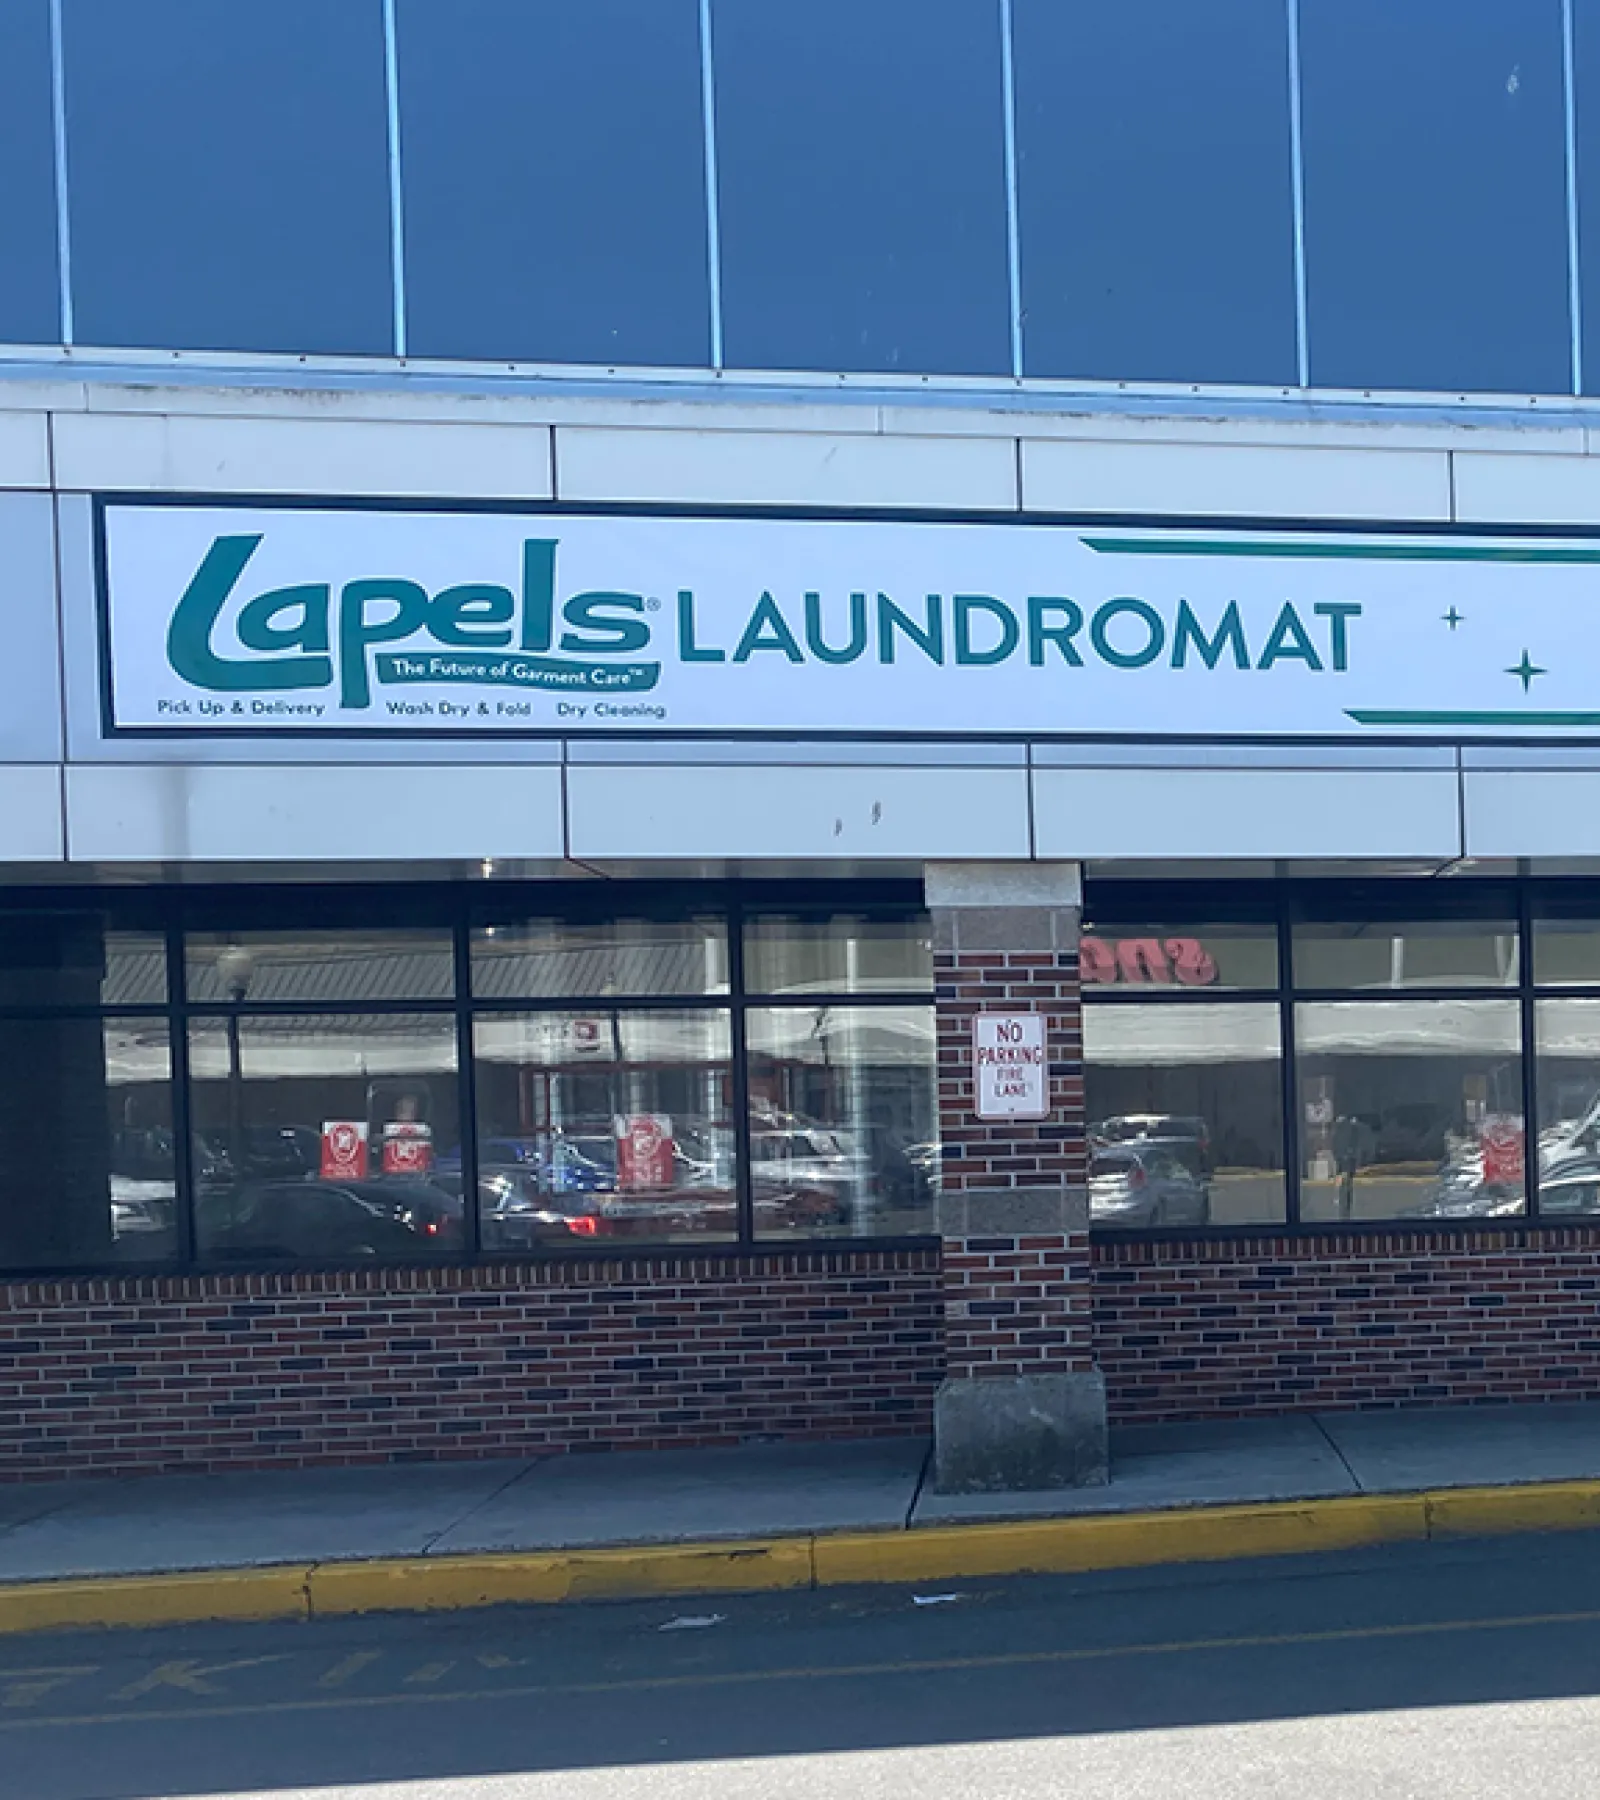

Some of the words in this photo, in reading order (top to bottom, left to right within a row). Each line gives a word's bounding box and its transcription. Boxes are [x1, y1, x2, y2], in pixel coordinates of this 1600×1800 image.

[167, 533, 652, 709] Lapels
[677, 591, 1362, 672] LAUNDROMAT
[391, 657, 425, 675] The
[429, 657, 486, 676] Future
[489, 660, 509, 677] of
[513, 663, 587, 684] Garment
[157, 700, 193, 715] Pick
[199, 700, 226, 718] Up
[230, 700, 245, 715] &
[251, 700, 326, 718] Delivery
[385, 700, 434, 716] Wash
[438, 701, 470, 719] Dry
[477, 702, 490, 717] &
[496, 702, 532, 717] Fold
[556, 702, 588, 719] Dry
[593, 702, 667, 721] Cleaning
[996, 1023, 1023, 1043] NO
[977, 1045, 1041, 1066] PARKING
